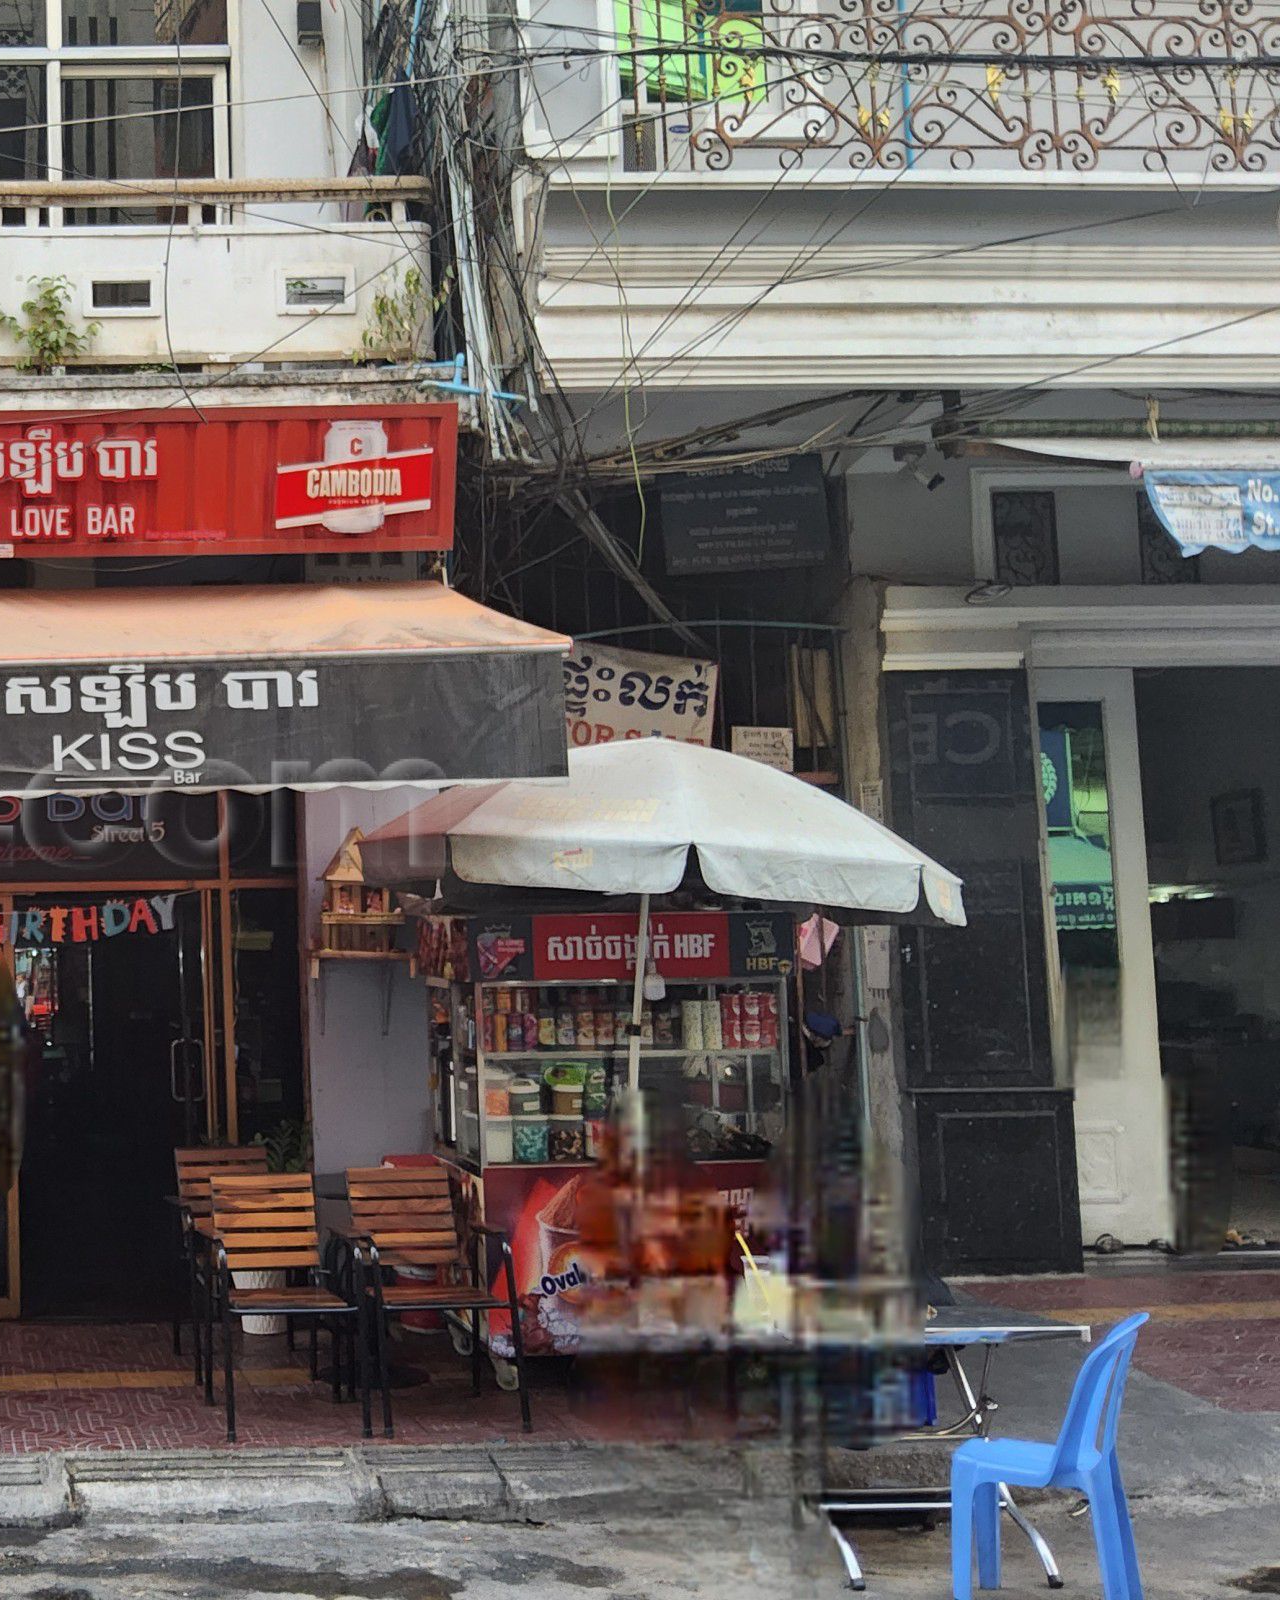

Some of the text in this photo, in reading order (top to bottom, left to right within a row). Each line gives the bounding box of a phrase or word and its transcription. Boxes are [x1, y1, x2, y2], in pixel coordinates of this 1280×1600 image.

[306, 468, 402, 499] CAMBODIA
[1248, 479, 1279, 503] No.
[11, 508, 70, 536] LOVE
[87, 506, 135, 535] BAR
[1251, 511, 1280, 537] St.
[566, 718, 614, 746] OR
[52, 731, 206, 772] KISS
[174, 769, 202, 784] Bar
[91, 821, 165, 843] Street 5
[675, 933, 716, 959] HBF
[746, 957, 779, 972] HBF
